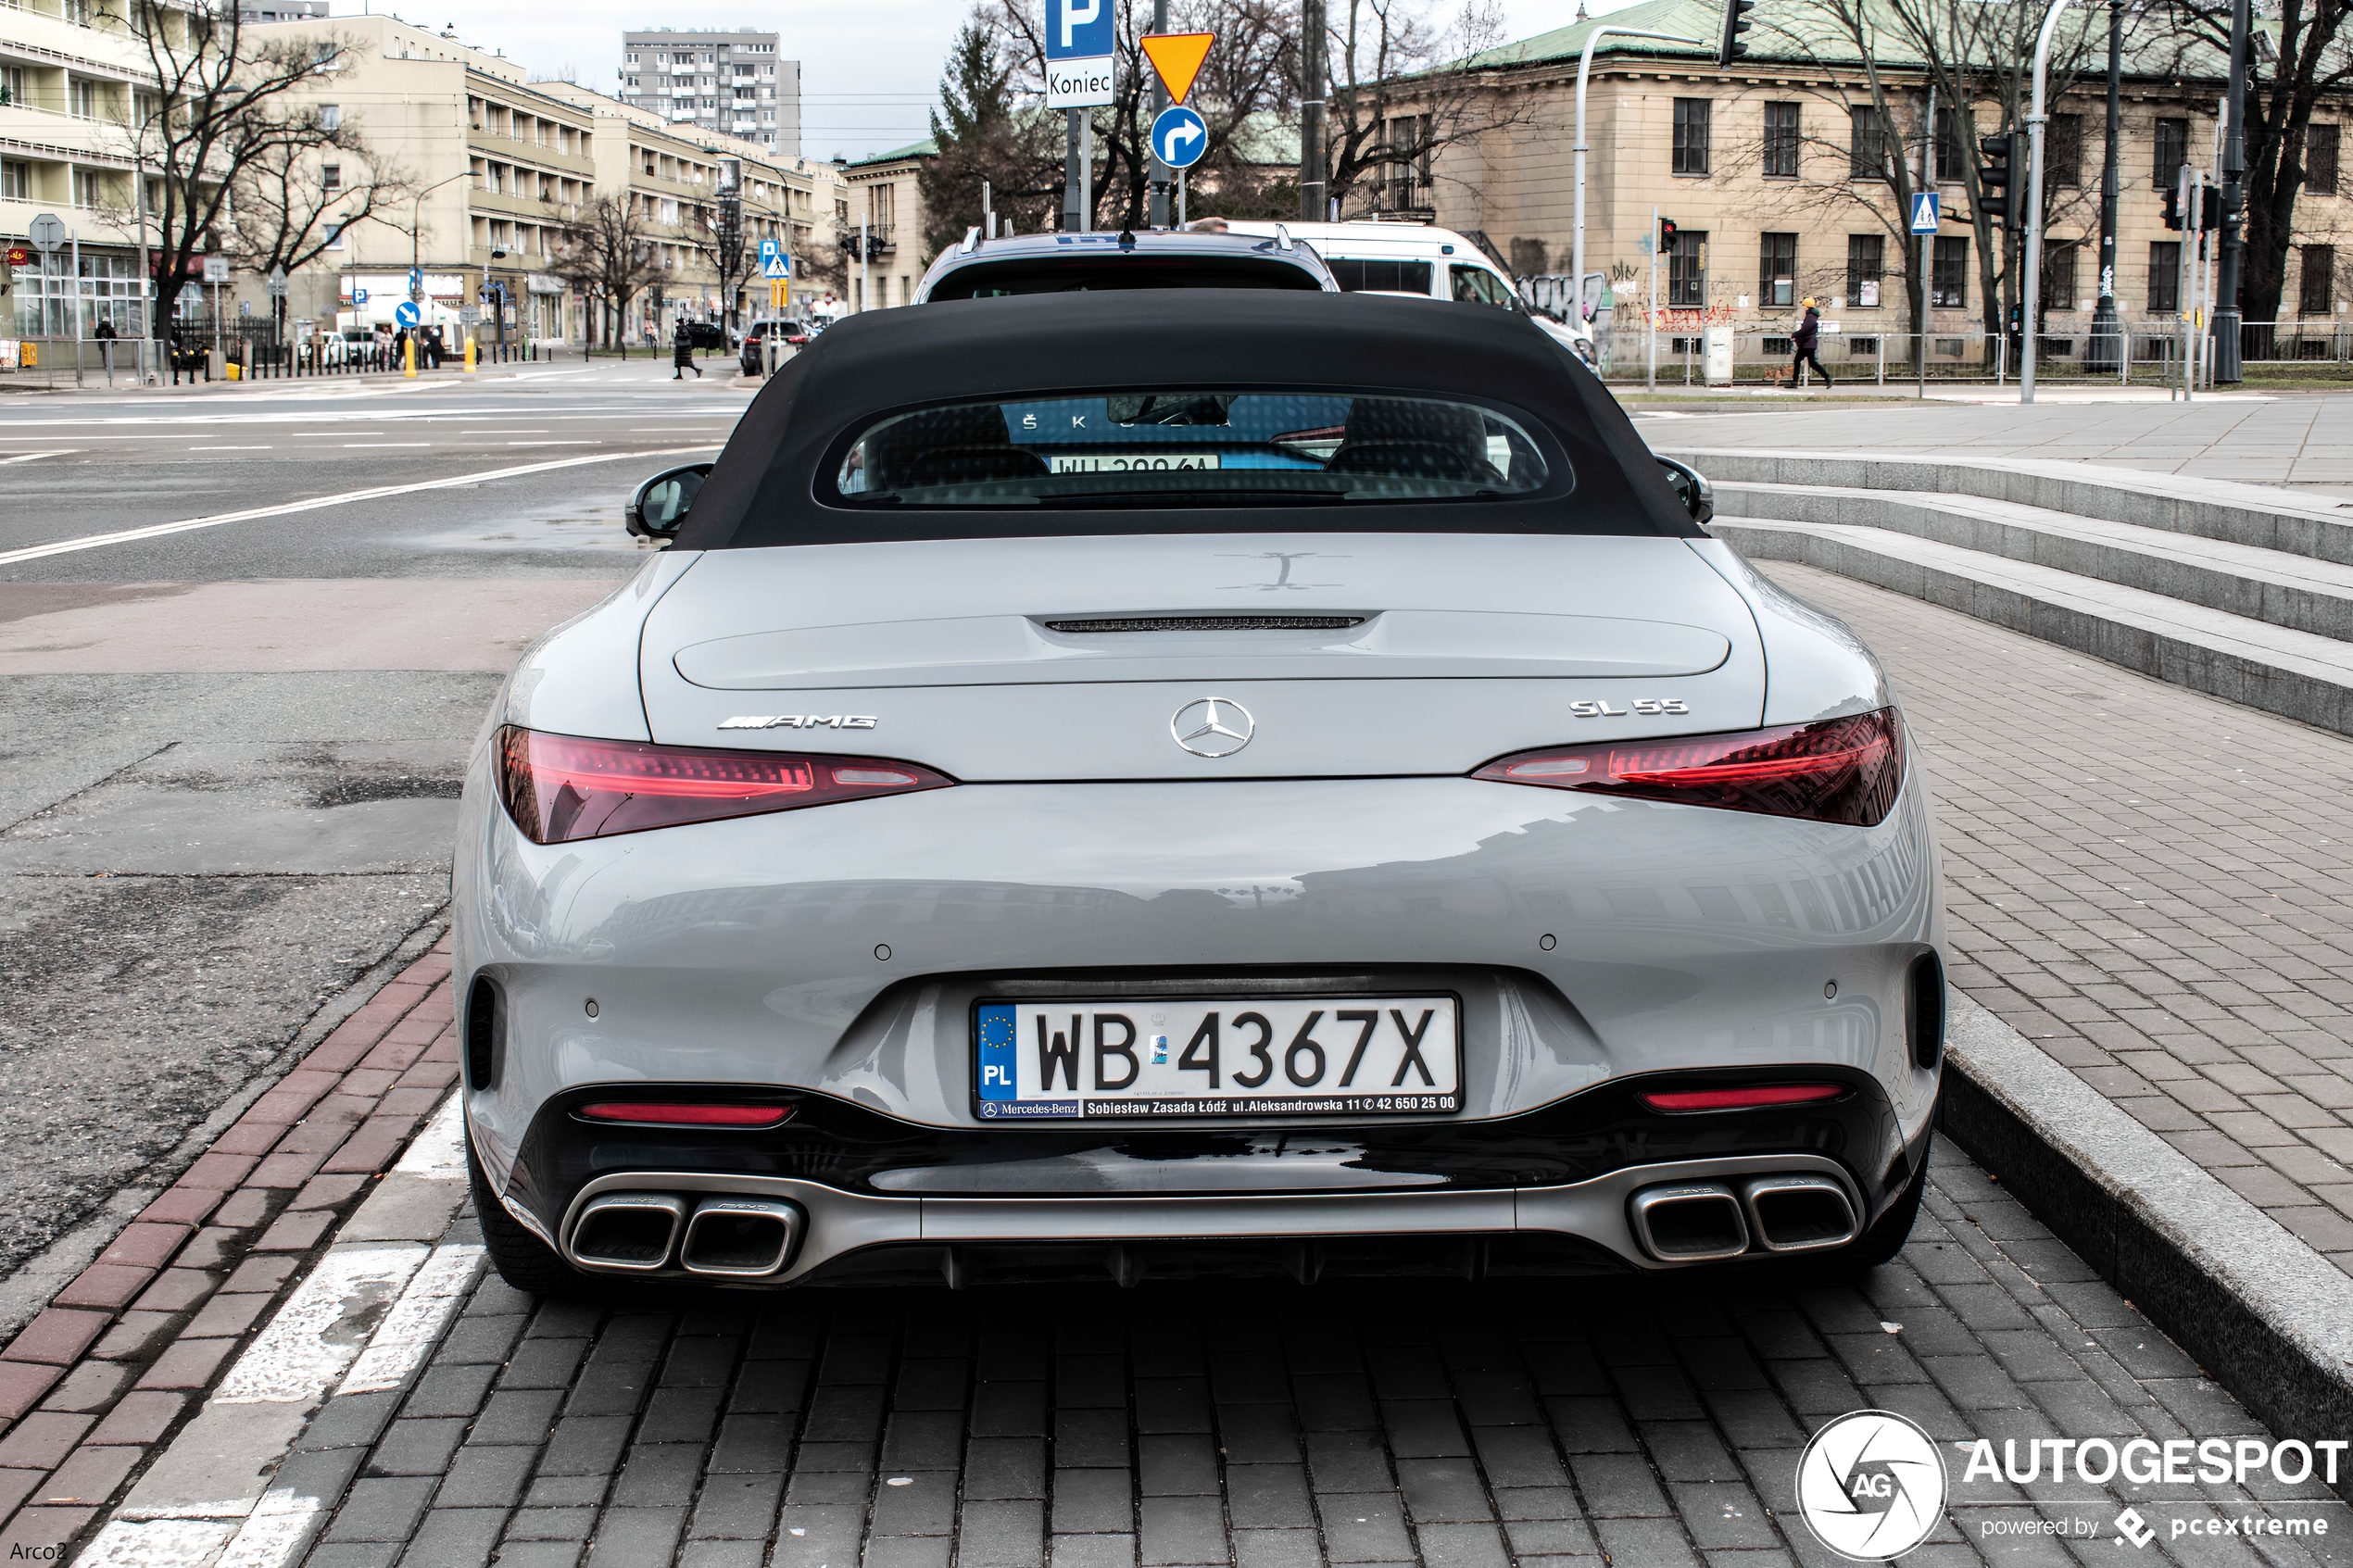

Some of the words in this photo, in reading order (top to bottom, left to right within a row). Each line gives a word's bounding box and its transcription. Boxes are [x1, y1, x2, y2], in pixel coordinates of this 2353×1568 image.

[1061, 0, 1101, 47] P
[1050, 71, 1110, 94] Koniec
[355, 290, 365, 303] P
[1569, 700, 1628, 718] SL
[1631, 698, 1690, 715] 55
[766, 714, 878, 729] AMG
[1036, 1013, 1140, 1091] WB
[1177, 1009, 1437, 1089] 4367X
[984, 1065, 1012, 1085] PL
[1001, 1103, 1076, 1114] Mercedes-Benz
[1088, 1102, 1150, 1114] Sobiesław
[1152, 1101, 1195, 1113] Zasada
[1198, 1100, 1227, 1112] Łódź
[1346, 1098, 1360, 1110] 11
[1377, 1098, 1391, 1110] 42
[1395, 1097, 1418, 1110] 650
[1421, 1097, 1437, 1109] 25
[1440, 1096, 1455, 1109] 00
